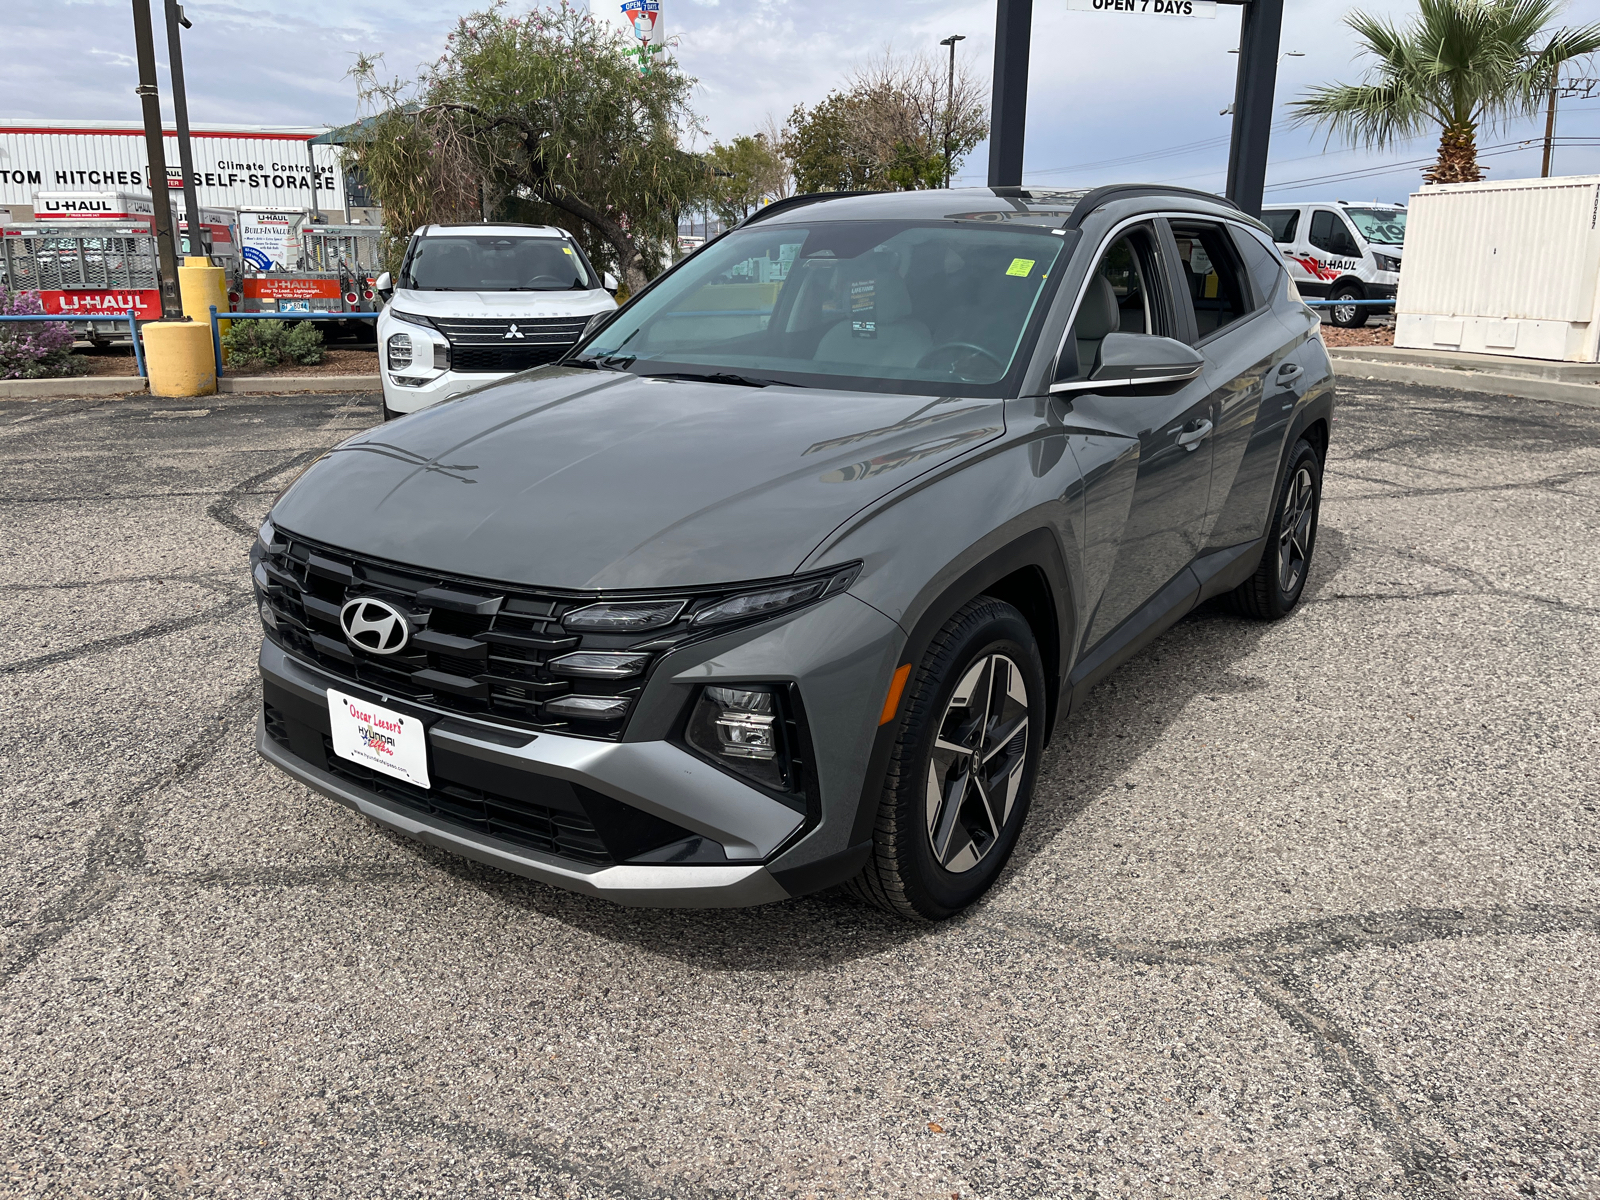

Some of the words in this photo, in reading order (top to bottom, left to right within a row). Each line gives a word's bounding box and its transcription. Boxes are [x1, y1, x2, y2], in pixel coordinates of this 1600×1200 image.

[625, 1, 640, 9] OPEN
[1092, 0, 1135, 11] OPEN
[1141, 0, 1150, 12] 7
[1154, 0, 1193, 14] DAYS
[218, 161, 264, 171] Climate
[272, 162, 334, 174] Controled
[56, 171, 142, 184] HITCHES
[193, 172, 335, 190] SELF-STORAGE
[46, 201, 111, 210] U-HAUL
[1318, 260, 1356, 270] U-HAUL
[59, 296, 148, 309] U-HAUL
[350, 704, 371, 723] Oscar
[374, 714, 401, 734] Leeser's
[358, 725, 395, 747] HYUNDAI
